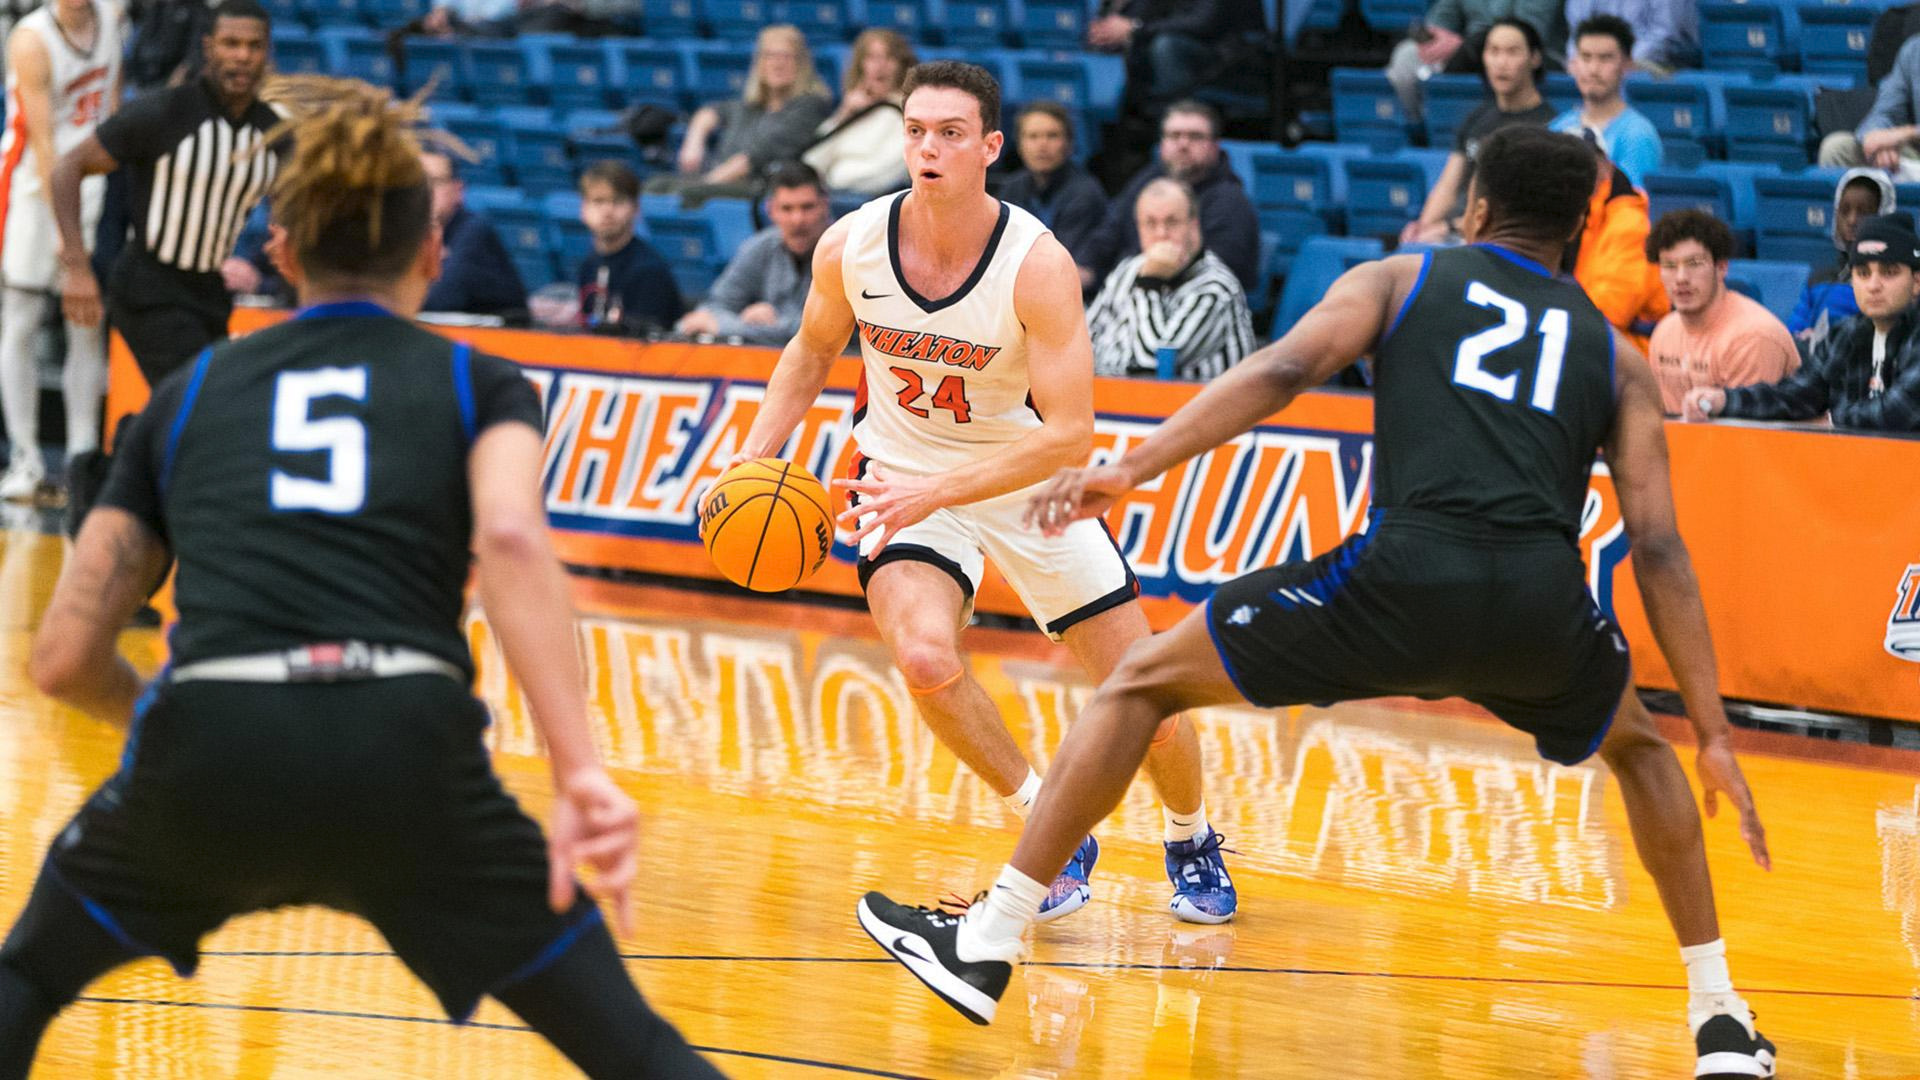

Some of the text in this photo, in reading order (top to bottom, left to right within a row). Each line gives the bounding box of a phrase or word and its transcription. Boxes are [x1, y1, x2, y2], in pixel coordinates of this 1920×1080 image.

[858, 319, 1001, 371] WHEATON
[1452, 280, 1571, 414] 21
[270, 364, 369, 517] 5
[889, 366, 971, 424] 24
